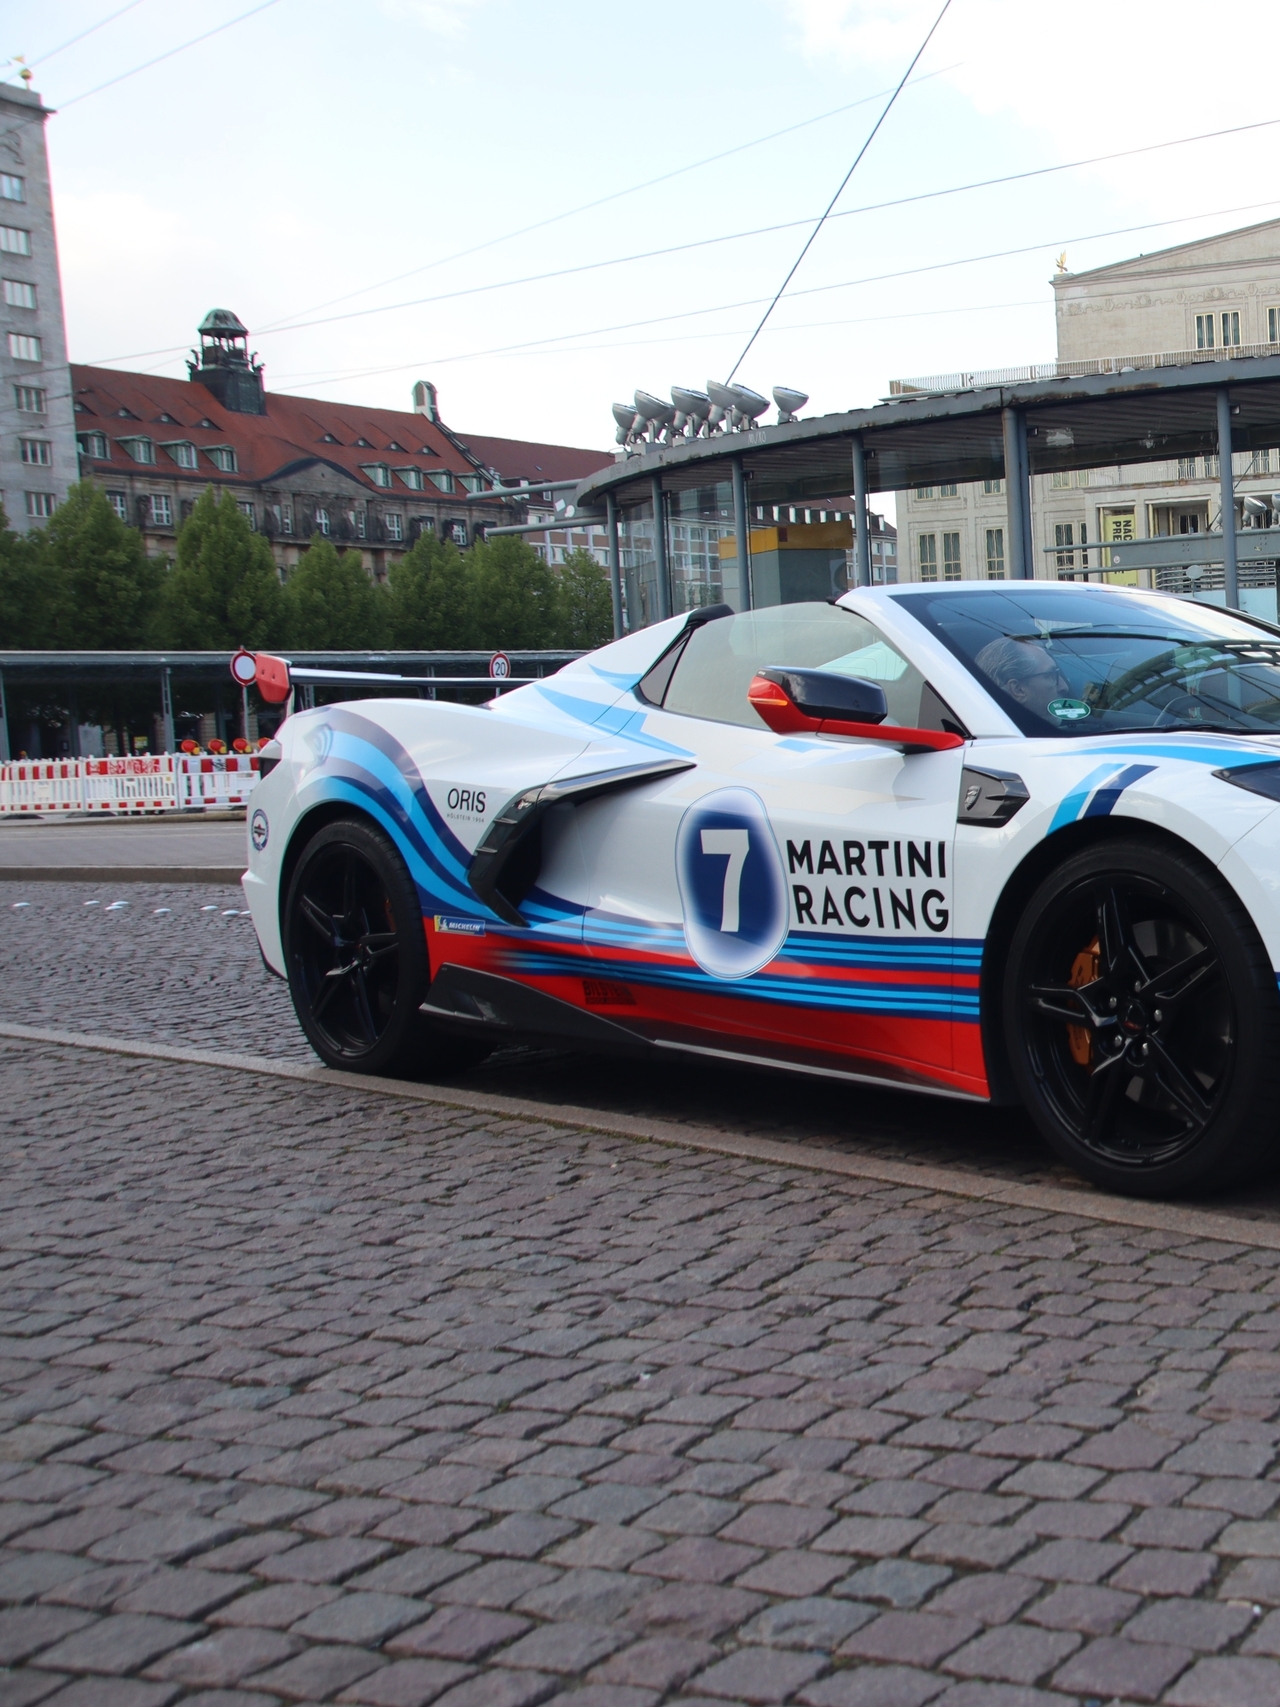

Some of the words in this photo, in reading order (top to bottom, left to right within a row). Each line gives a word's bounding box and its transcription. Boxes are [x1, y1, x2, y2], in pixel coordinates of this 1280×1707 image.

[494, 661, 506, 676] 20
[447, 788, 486, 813] ORIS
[786, 839, 947, 878] MARTINI
[700, 829, 750, 933] 7
[792, 884, 950, 933] RACING
[448, 922, 481, 931] MICHELIN
